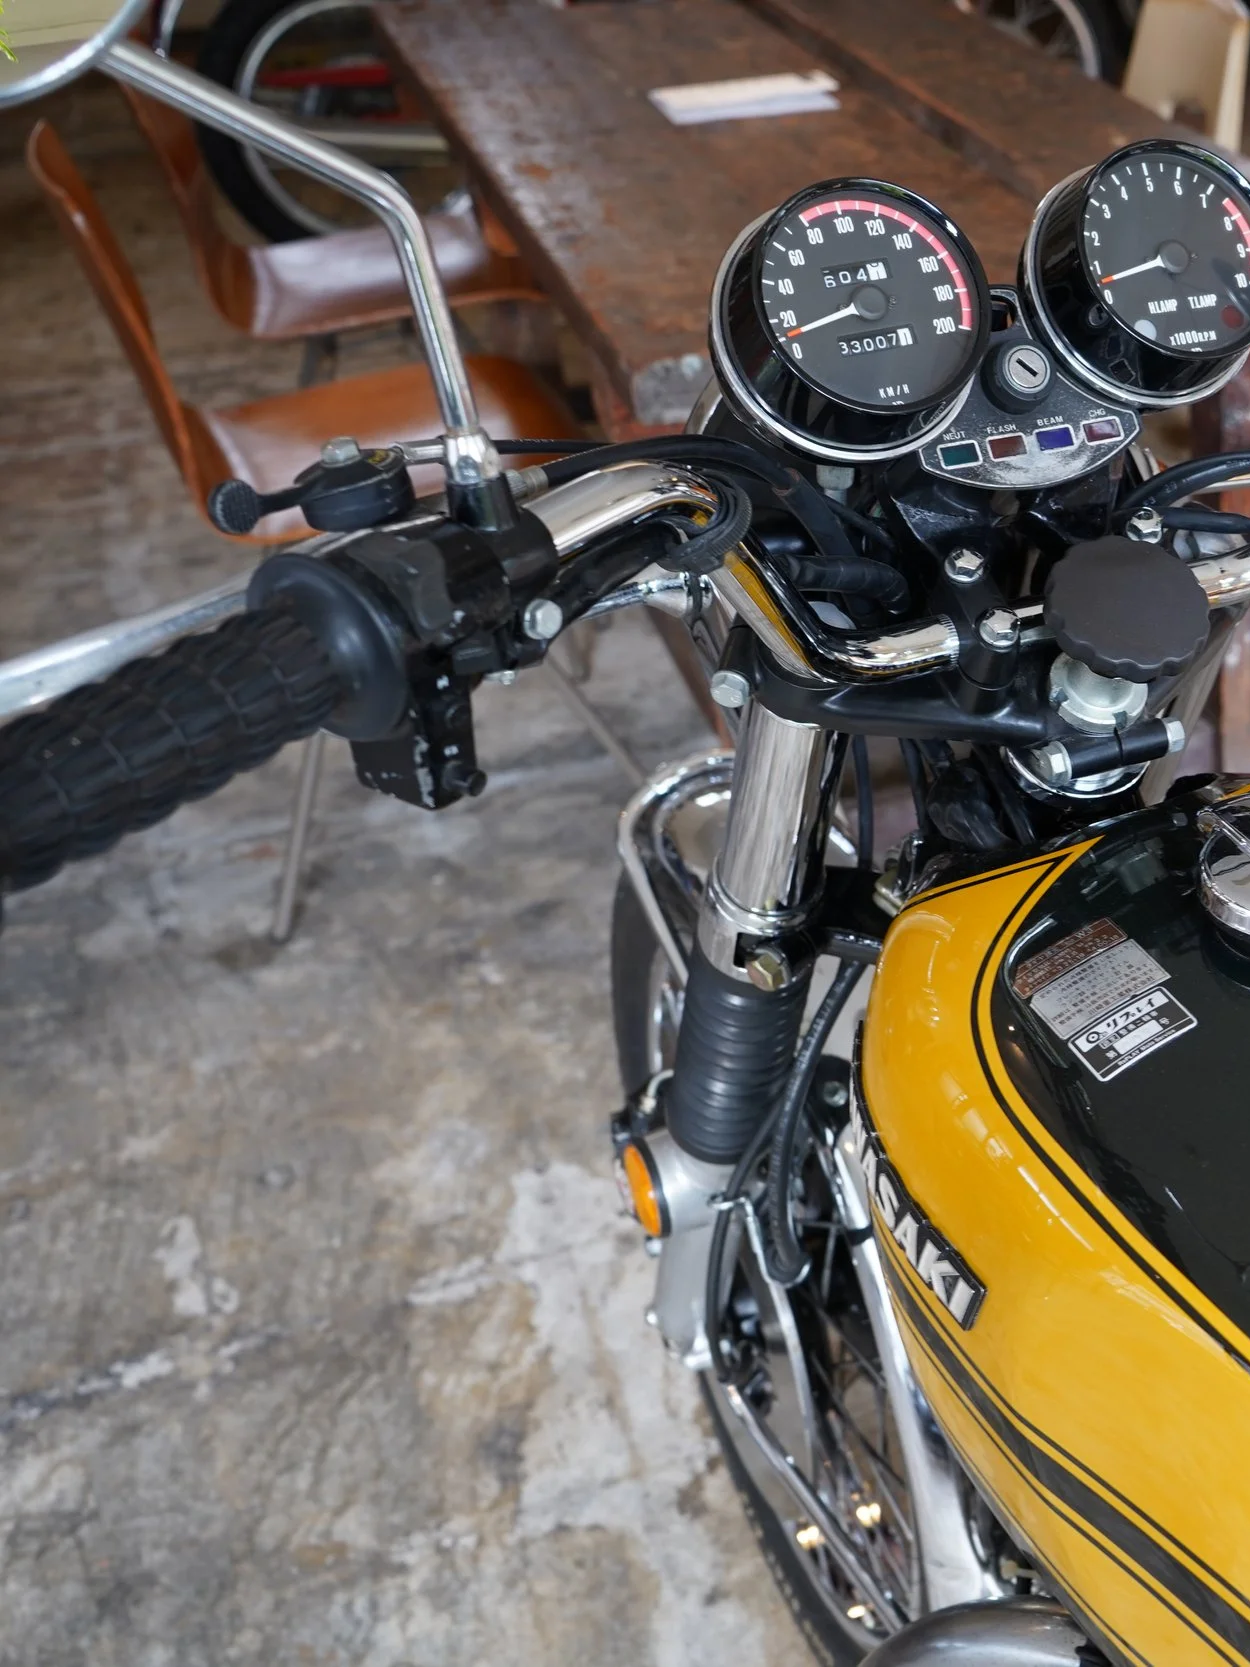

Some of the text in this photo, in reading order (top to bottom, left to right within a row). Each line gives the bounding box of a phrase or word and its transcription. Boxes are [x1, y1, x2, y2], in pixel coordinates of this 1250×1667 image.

[1146, 178, 1154, 192] 5
[1174, 181, 1183, 195] 6
[1120, 186, 1128, 201] 4
[1199, 194, 1207, 209] 7
[1102, 204, 1112, 219] 3
[833, 216, 854, 234] 100
[864, 219, 886, 236] 120
[1224, 217, 1233, 231] 8
[806, 228, 824, 245] 80
[892, 233, 913, 250] 140
[1091, 231, 1101, 246] 2
[788, 249, 805, 266] 60
[1237, 244, 1246, 258] 9
[917, 256, 939, 273] 160
[1093, 261, 1102, 275] 1
[777, 279, 795, 295] 40
[1234, 273, 1248, 288] 10
[932, 284, 954, 302] 180
[1104, 289, 1114, 305] 0
[779, 310, 797, 328] 20
[933, 317, 956, 335] 200
[792, 343, 803, 359] 0
[878, 384, 910, 399] KM/H
[1036, 415, 1064, 426] BEAM
[1087, 408, 1107, 418] CHG
[943, 430, 967, 441] NEUT
[986, 424, 1017, 434] FLASH
[1105, 997, 1156, 1030] リプレイ
